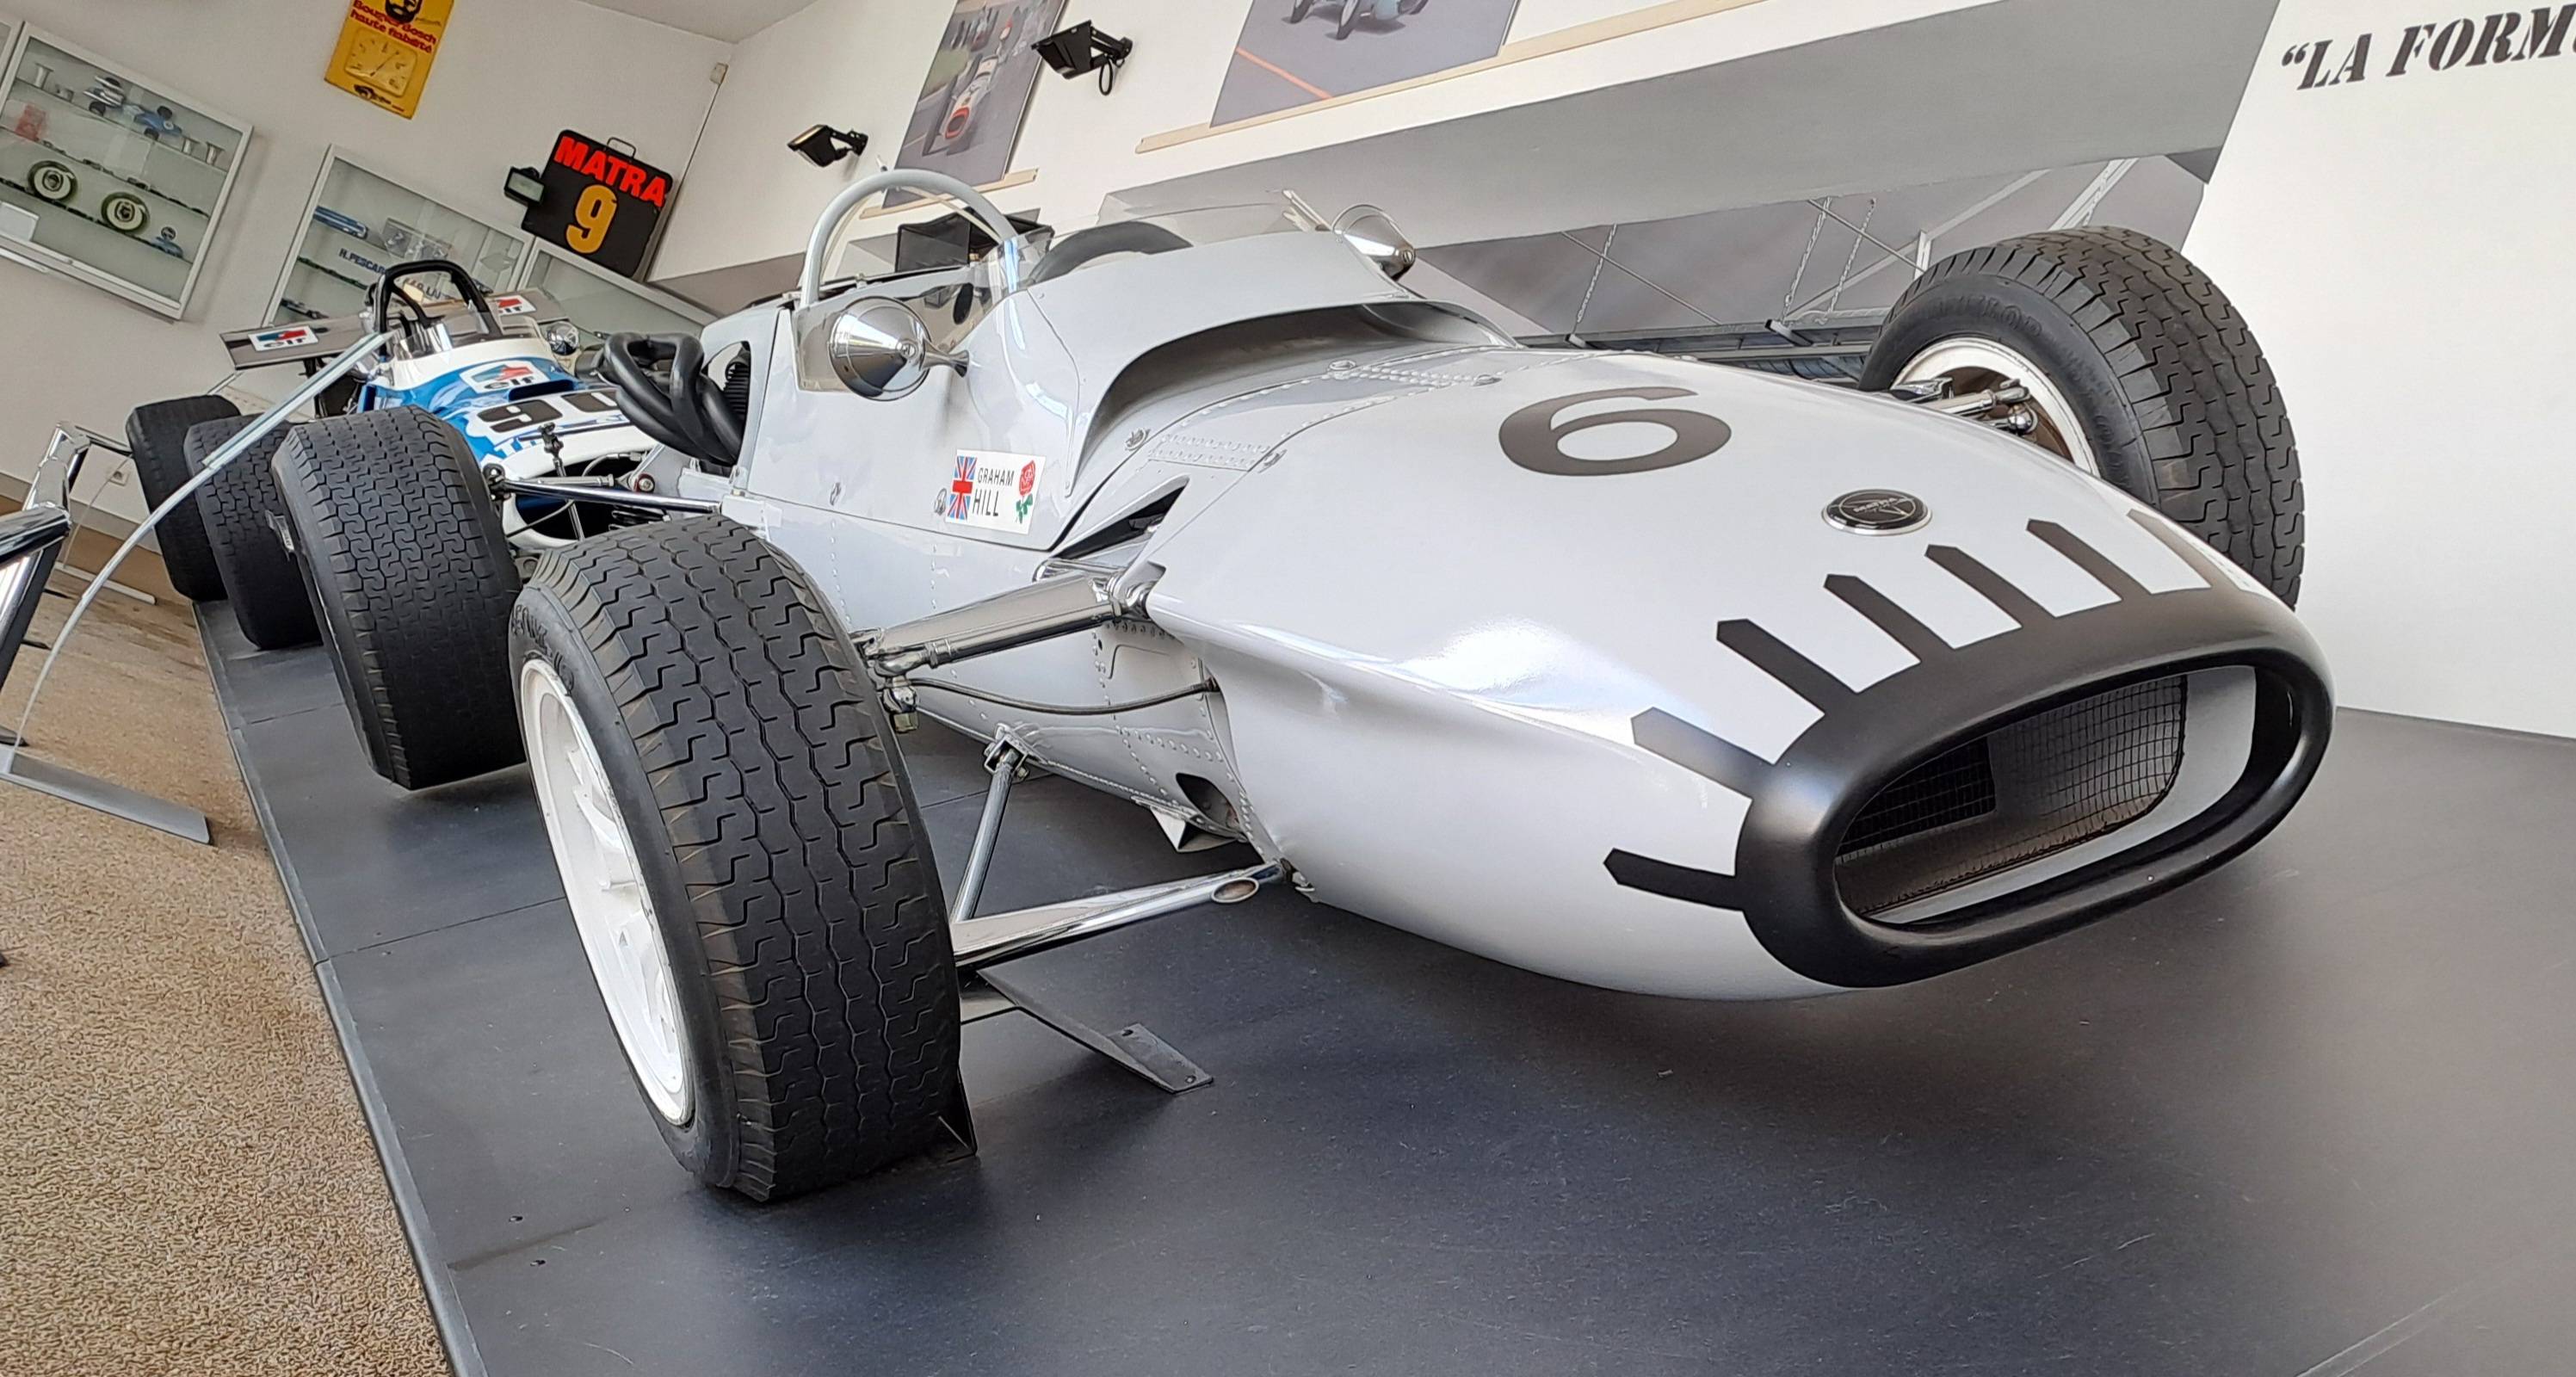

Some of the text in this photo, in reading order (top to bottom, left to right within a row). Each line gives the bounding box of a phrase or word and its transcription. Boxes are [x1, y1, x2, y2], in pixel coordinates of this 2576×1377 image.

[2385, 3, 2576, 77] FORM
[553, 136, 666, 207] MATRA
[565, 184, 618, 254] 9
[484, 376, 535, 390] elf
[1498, 386, 1732, 477] 6
[972, 489, 999, 516] HILL
[978, 467, 1015, 486] GRAHAM
